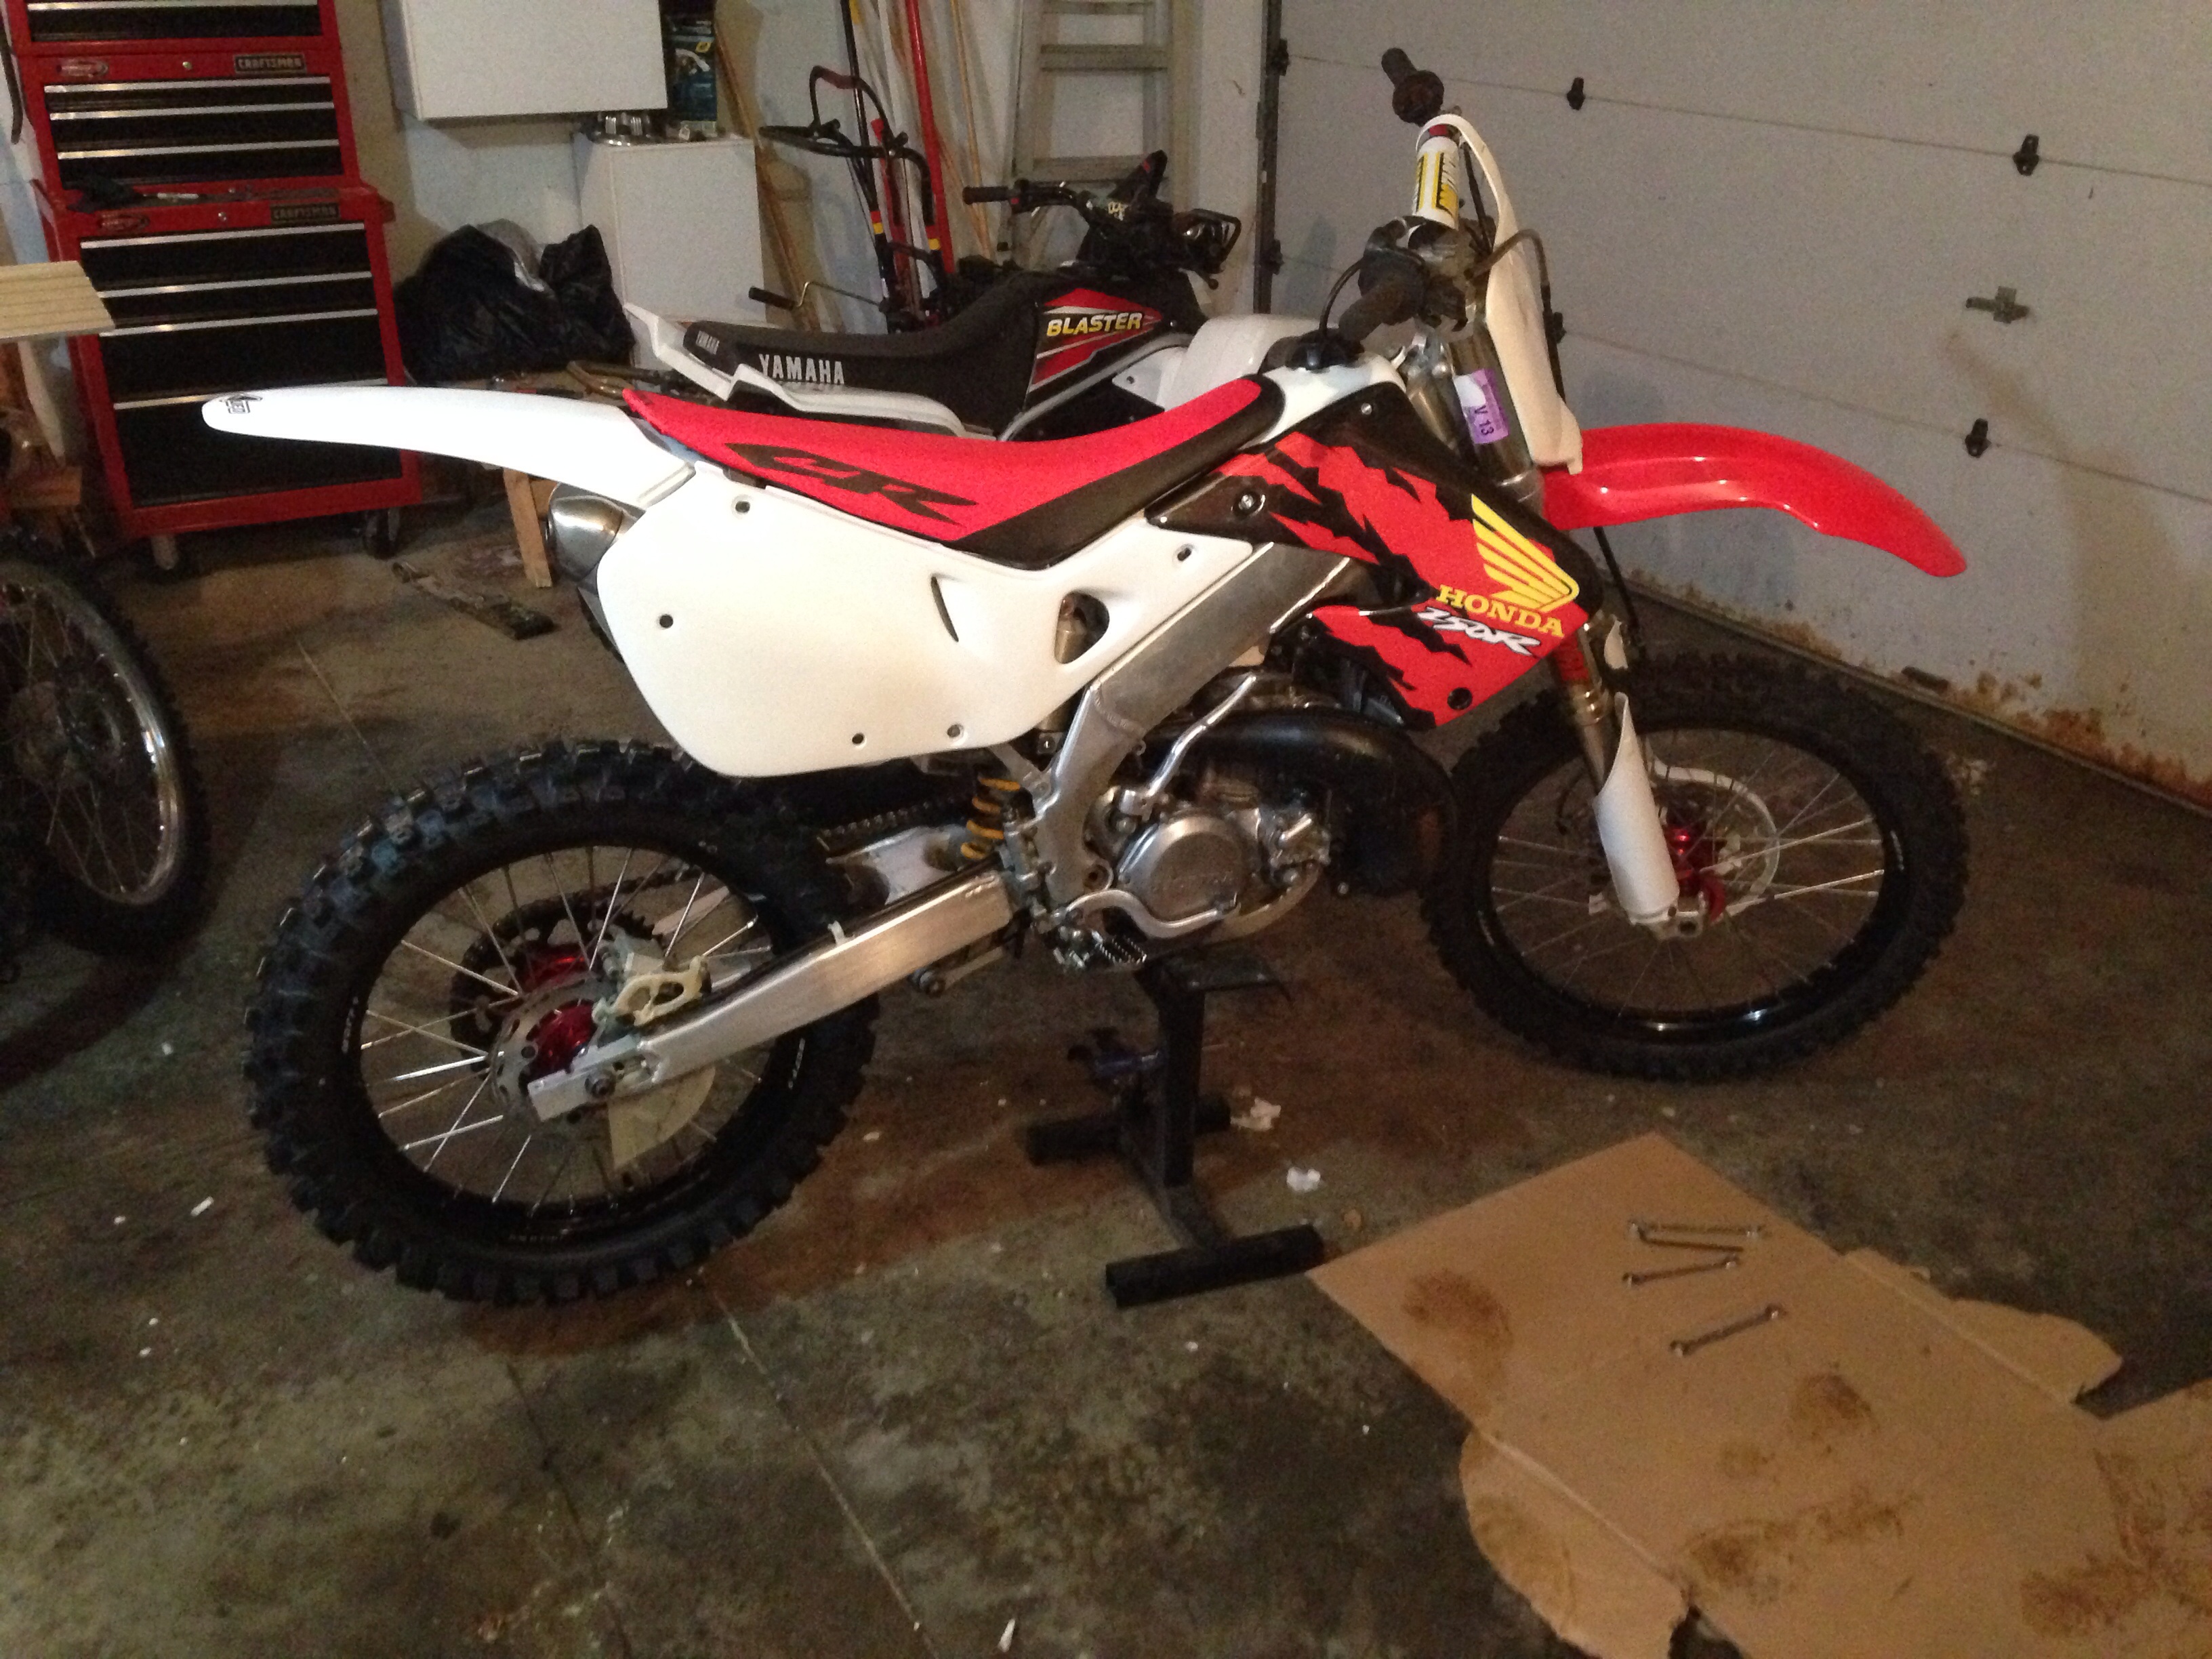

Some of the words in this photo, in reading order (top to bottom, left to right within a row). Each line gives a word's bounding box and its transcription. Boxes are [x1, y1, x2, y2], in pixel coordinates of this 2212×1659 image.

[1046, 312, 1143, 337] BLASTER
[758, 352, 846, 385] YAMAHA
[1478, 418, 1495, 436] 13
[1435, 583, 1565, 638] HONDA
[1416, 605, 1541, 657] 250R
